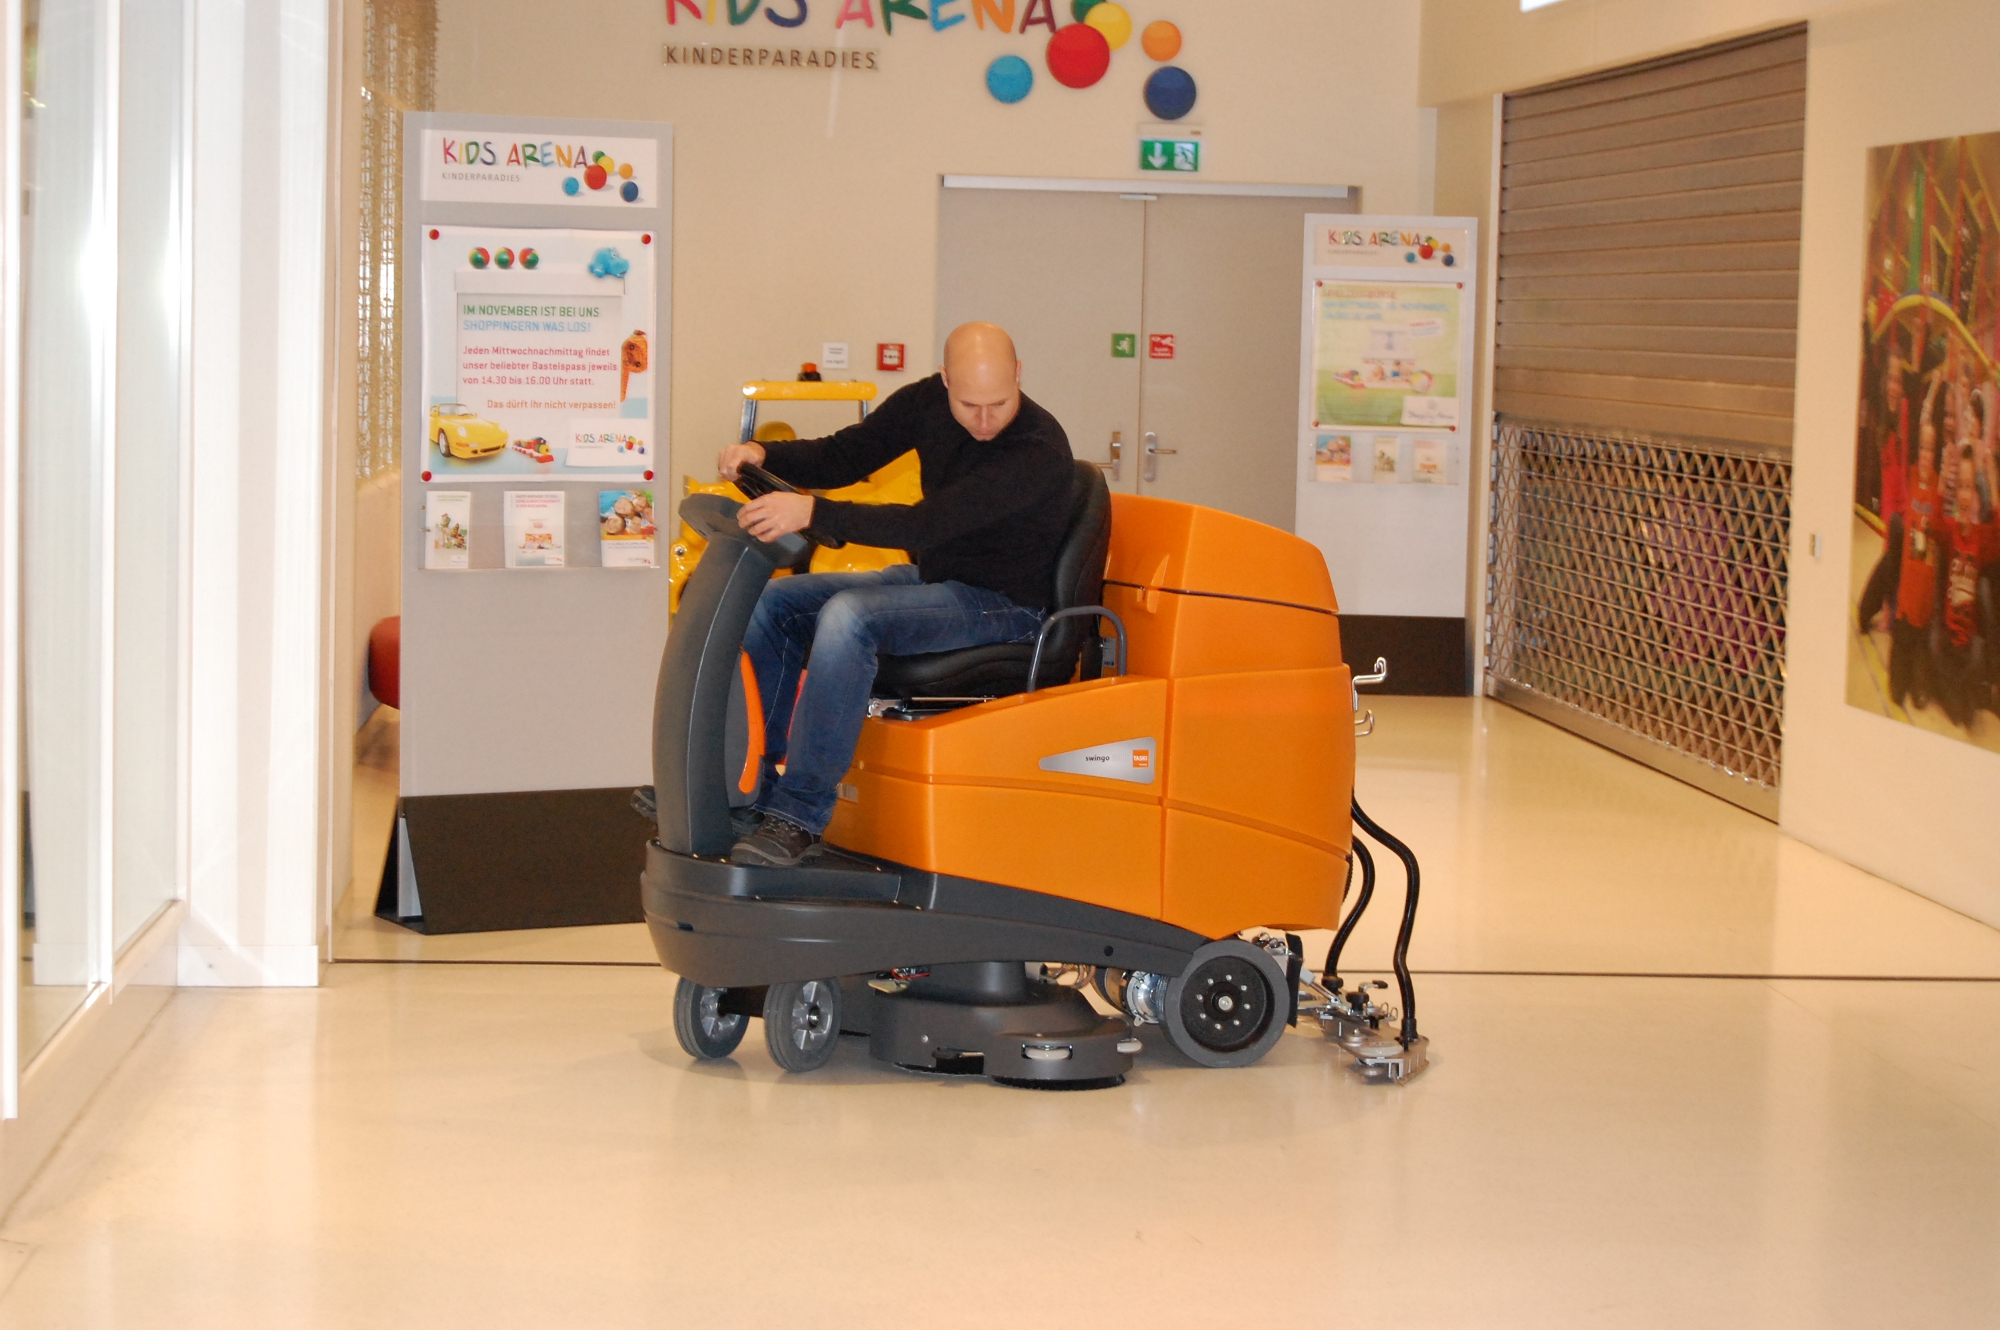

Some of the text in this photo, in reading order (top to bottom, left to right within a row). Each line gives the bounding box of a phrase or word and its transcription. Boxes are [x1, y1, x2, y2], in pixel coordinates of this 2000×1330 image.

[665, 46, 878, 70] KINDERPARADIES
[442, 137, 589, 169] KIDS ARENA
[442, 172, 520, 182] KINDERPARADIES
[1368, 230, 1422, 247] ARENA
[463, 304, 599, 317] IM NOVEMBER IST BEI UNS
[542, 321, 565, 332] WAS
[568, 322, 591, 332] LOS!
[463, 346, 610, 358] Jeden Mittwochnachmittag findet
[463, 361, 617, 373] unser beliebter Bastelspass jeweils
[463, 376, 595, 385] von 14.30 bis 16.00 Uhr statt.
[487, 399, 616, 411] Das dürft Ihr nicht verpassen!
[575, 433, 628, 443] KIDS ARENA
[1085, 754, 1110, 762] swingo
